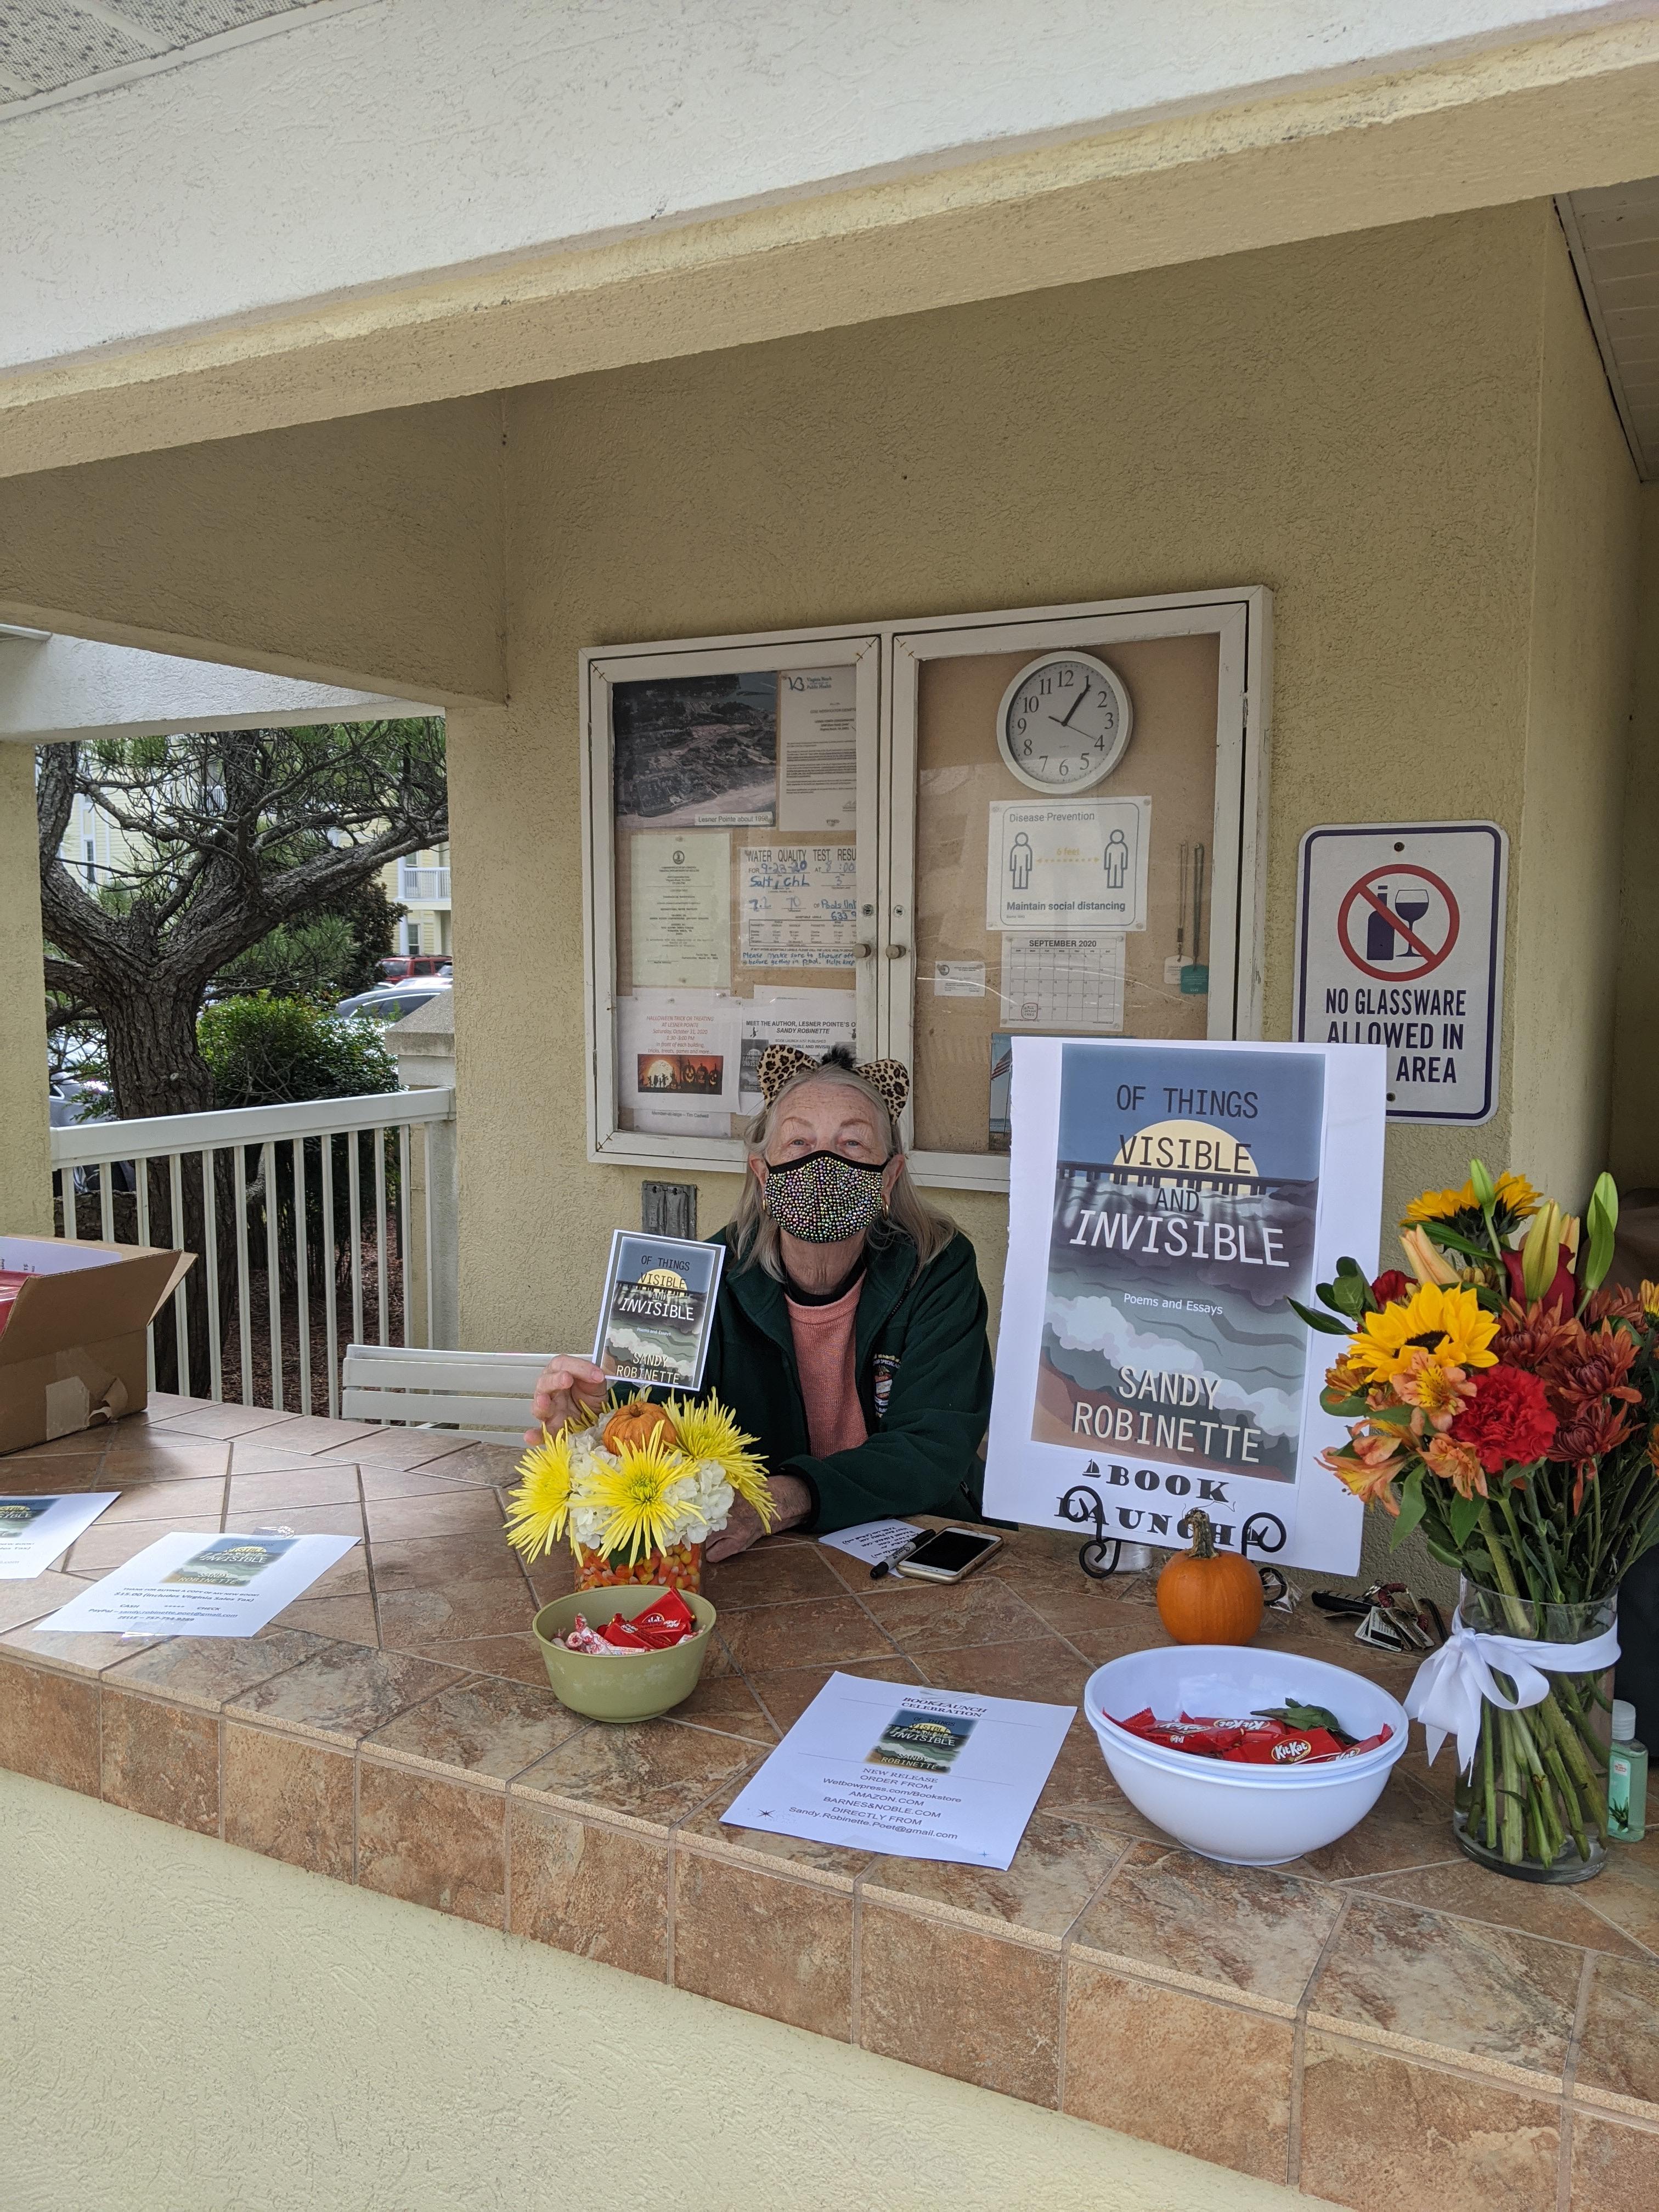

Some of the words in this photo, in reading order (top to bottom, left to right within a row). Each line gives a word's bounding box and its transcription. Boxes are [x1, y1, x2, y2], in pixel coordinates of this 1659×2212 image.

[1040, 678, 1052, 695] 11
[1058, 670, 1074, 687] 12
[1084, 675, 1091, 692] 1
[1023, 696, 1039, 713] 10
[1097, 691, 1107, 708] 2
[1018, 718, 1026, 736] 9
[1104, 712, 1114, 730] 3
[1024, 739, 1032, 755] 8
[1094, 735, 1104, 751] 4
[1039, 755, 1048, 772] 7
[1059, 759, 1069, 776] 6
[1080, 752, 1090, 770] 5
[1009, 814, 1045, 822] Disease
[1047, 812, 1094, 821] Prevention
[747, 850, 772, 862] WATER
[778, 850, 806, 861] QUALITY
[813, 849, 831, 861] TEST
[837, 849, 856, 861] RESU
[1063, 847, 1080, 855] feet
[1007, 901, 1046, 911] Maintain
[1048, 901, 1075, 910] social
[1077, 901, 1125, 912] distancing
[1326, 989, 1348, 1014] NO
[1356, 989, 1466, 1016] GLASSWARE
[1328, 1022, 1434, 1049] ALLOWED
[1443, 1024, 1463, 1049] IN
[1396, 1057, 1457, 1083] AREA
[1116, 1085, 1146, 1111] OF
[1164, 1087, 1259, 1119] THINGS
[1120, 1135, 1252, 1175] VISIBLE
[1155, 1187, 1200, 1214] AND
[1069, 1210, 1290, 1267] INVISIBLE
[641, 1255, 652, 1265] OF
[658, 1257, 690, 1271] THINGS
[641, 1272, 686, 1289] VISIBLE
[652, 1291, 667, 1301] AND
[1124, 1293, 1159, 1308] Poems
[1162, 1298, 1183, 1311] and
[1186, 1300, 1223, 1316] Essays
[619, 1297, 694, 1321] INVISIBLE
[633, 1352, 668, 1368] SANDY
[616, 1365, 680, 1385] ROBINETTE
[1119, 1365, 1221, 1411] SANDY
[1073, 1401, 1261, 1463] ROBINETTE
[1106, 1464, 1231, 1503] BOOK
[901, 1702, 982, 1718] CELEBRATION
[902, 1697, 935, 1706] BOOK
[937, 1701, 988, 1713] LAUNCH
[911, 1723, 951, 1734] VISIBLE
[928, 1718, 956, 1726] THINGS
[890, 1731, 956, 1747] INVISIBLE
[881, 1757, 938, 1770] ROBINETTE
[897, 1753, 929, 1762] SANDY
[860, 1775, 899, 1785] ORDER
[900, 1781, 933, 1790] FROM
[862, 1768, 888, 1776] NEW
[890, 1772, 939, 1783] RELEASE
[823, 1778, 962, 1803] Wetbowpress.com/Bookstore
[849, 1791, 924, 1807] AMAZON.COM
[823, 1796, 941, 1818] BARNES&NOBLE.COM
[789, 1806, 958, 1839] Sandy.Robinette.Poet@gmail.com
[832, 1807, 887, 1820] DIRECTLY
[889, 1816, 922, 1826] FROM
